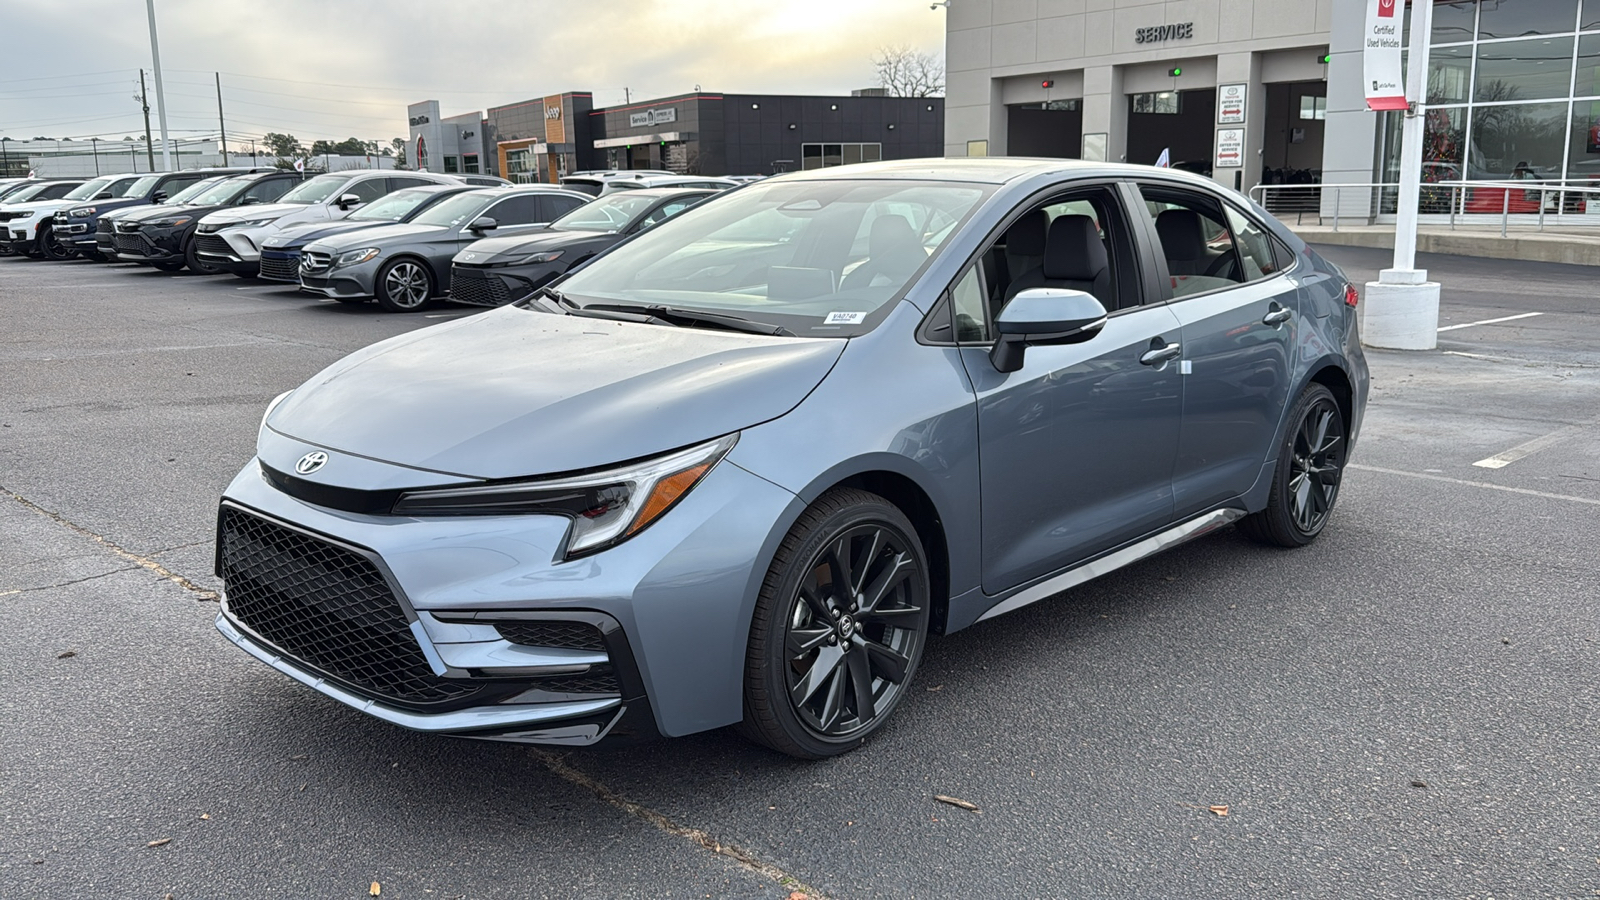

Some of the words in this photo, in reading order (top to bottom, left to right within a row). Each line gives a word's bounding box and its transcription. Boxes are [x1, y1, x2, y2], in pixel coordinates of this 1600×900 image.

[1135, 22, 1193, 43] SERVICE
[1373, 25, 1395, 35] Certified
[1366, 38, 1379, 48] Used
[1380, 38, 1400, 48] Vehicles
[545, 105, 560, 120] Jeep
[632, 115, 647, 124] Service
[796, 530, 829, 571] YOKOHAMA
